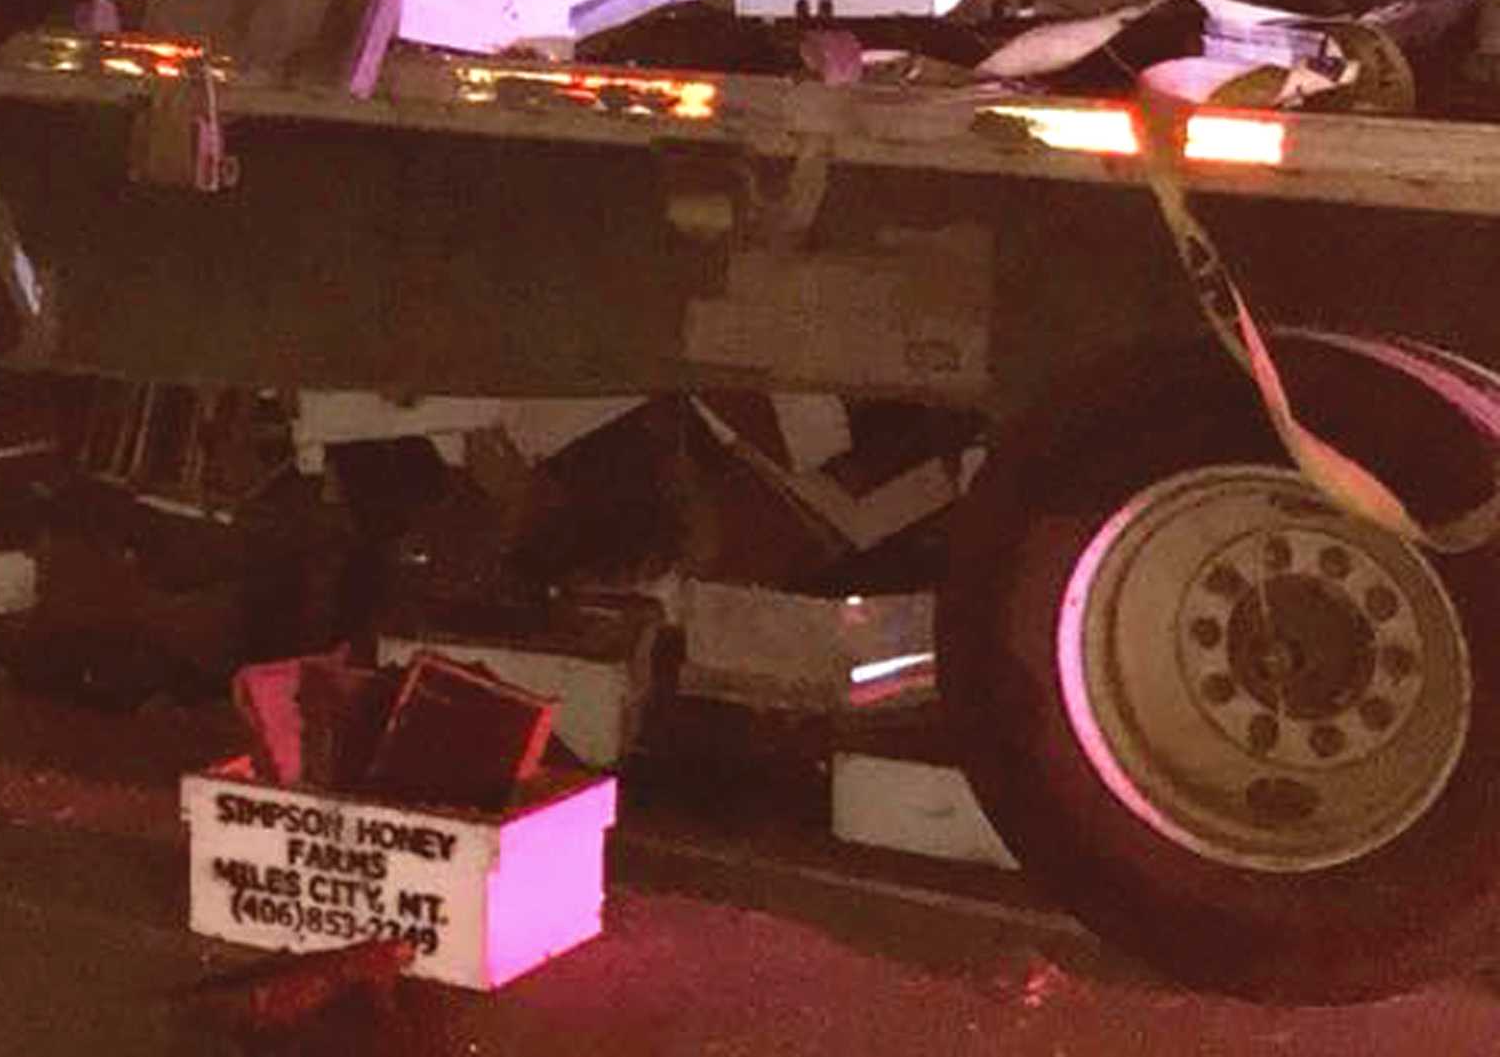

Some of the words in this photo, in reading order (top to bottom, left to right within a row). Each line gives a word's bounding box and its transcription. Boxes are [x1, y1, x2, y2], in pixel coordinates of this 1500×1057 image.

[216, 793, 344, 842] SIMPSON
[357, 817, 457, 860] HONEY
[213, 857, 301, 898] MILES
[287, 838, 387, 879] FARMS
